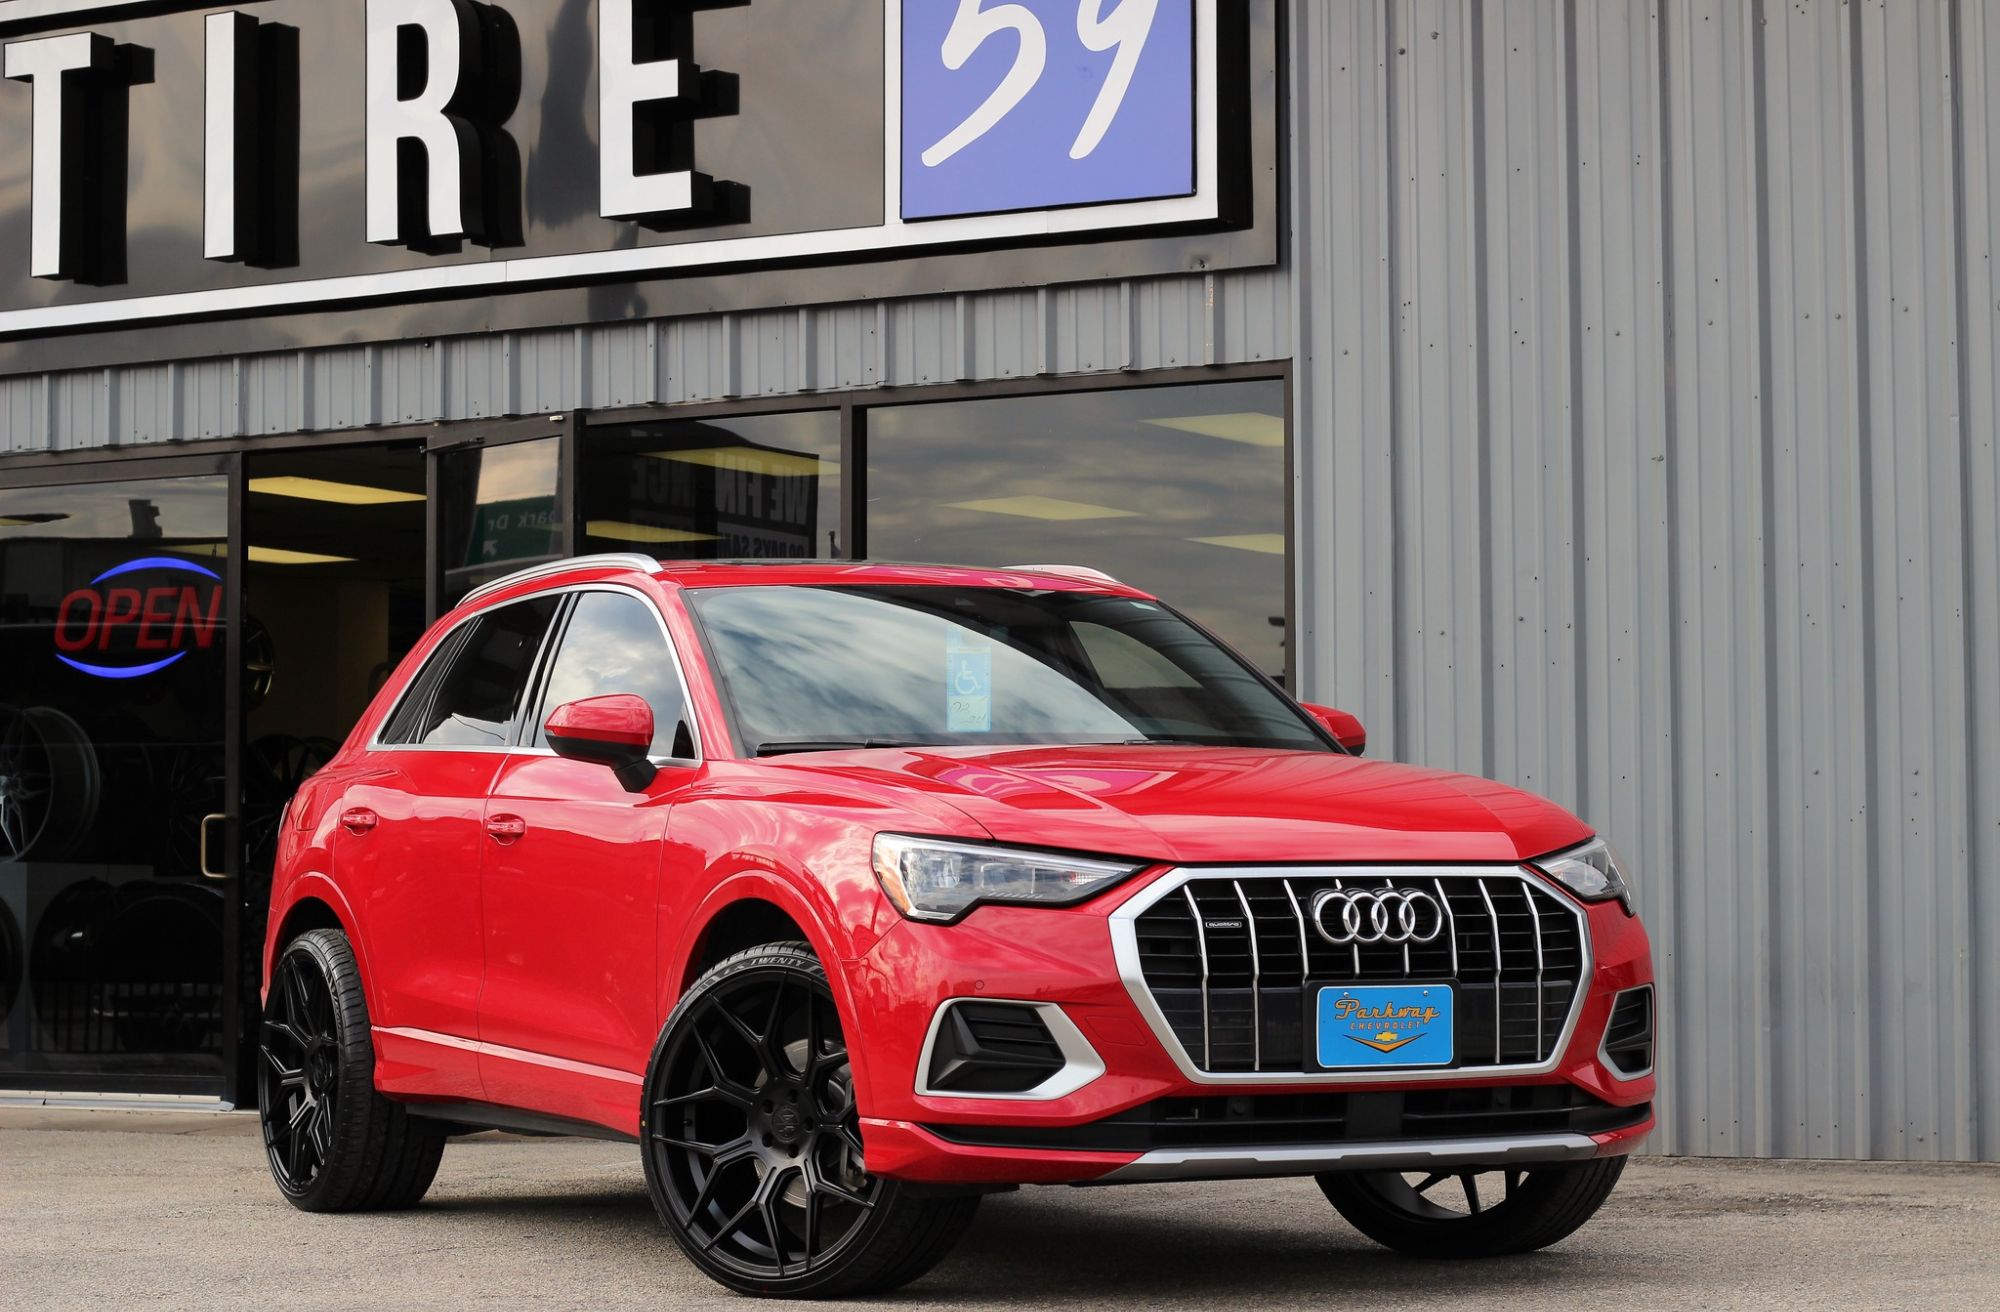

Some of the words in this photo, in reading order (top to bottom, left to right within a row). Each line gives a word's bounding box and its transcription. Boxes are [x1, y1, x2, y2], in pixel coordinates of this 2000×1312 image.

[922, 0, 1159, 167] 59
[4, 0, 692, 277] TIRE
[54, 585, 222, 650] OPEN
[750, 957, 806, 966] TWENTY
[1334, 998, 1440, 1024] Parkway
[1350, 1020, 1421, 1030] CHEVROLET
